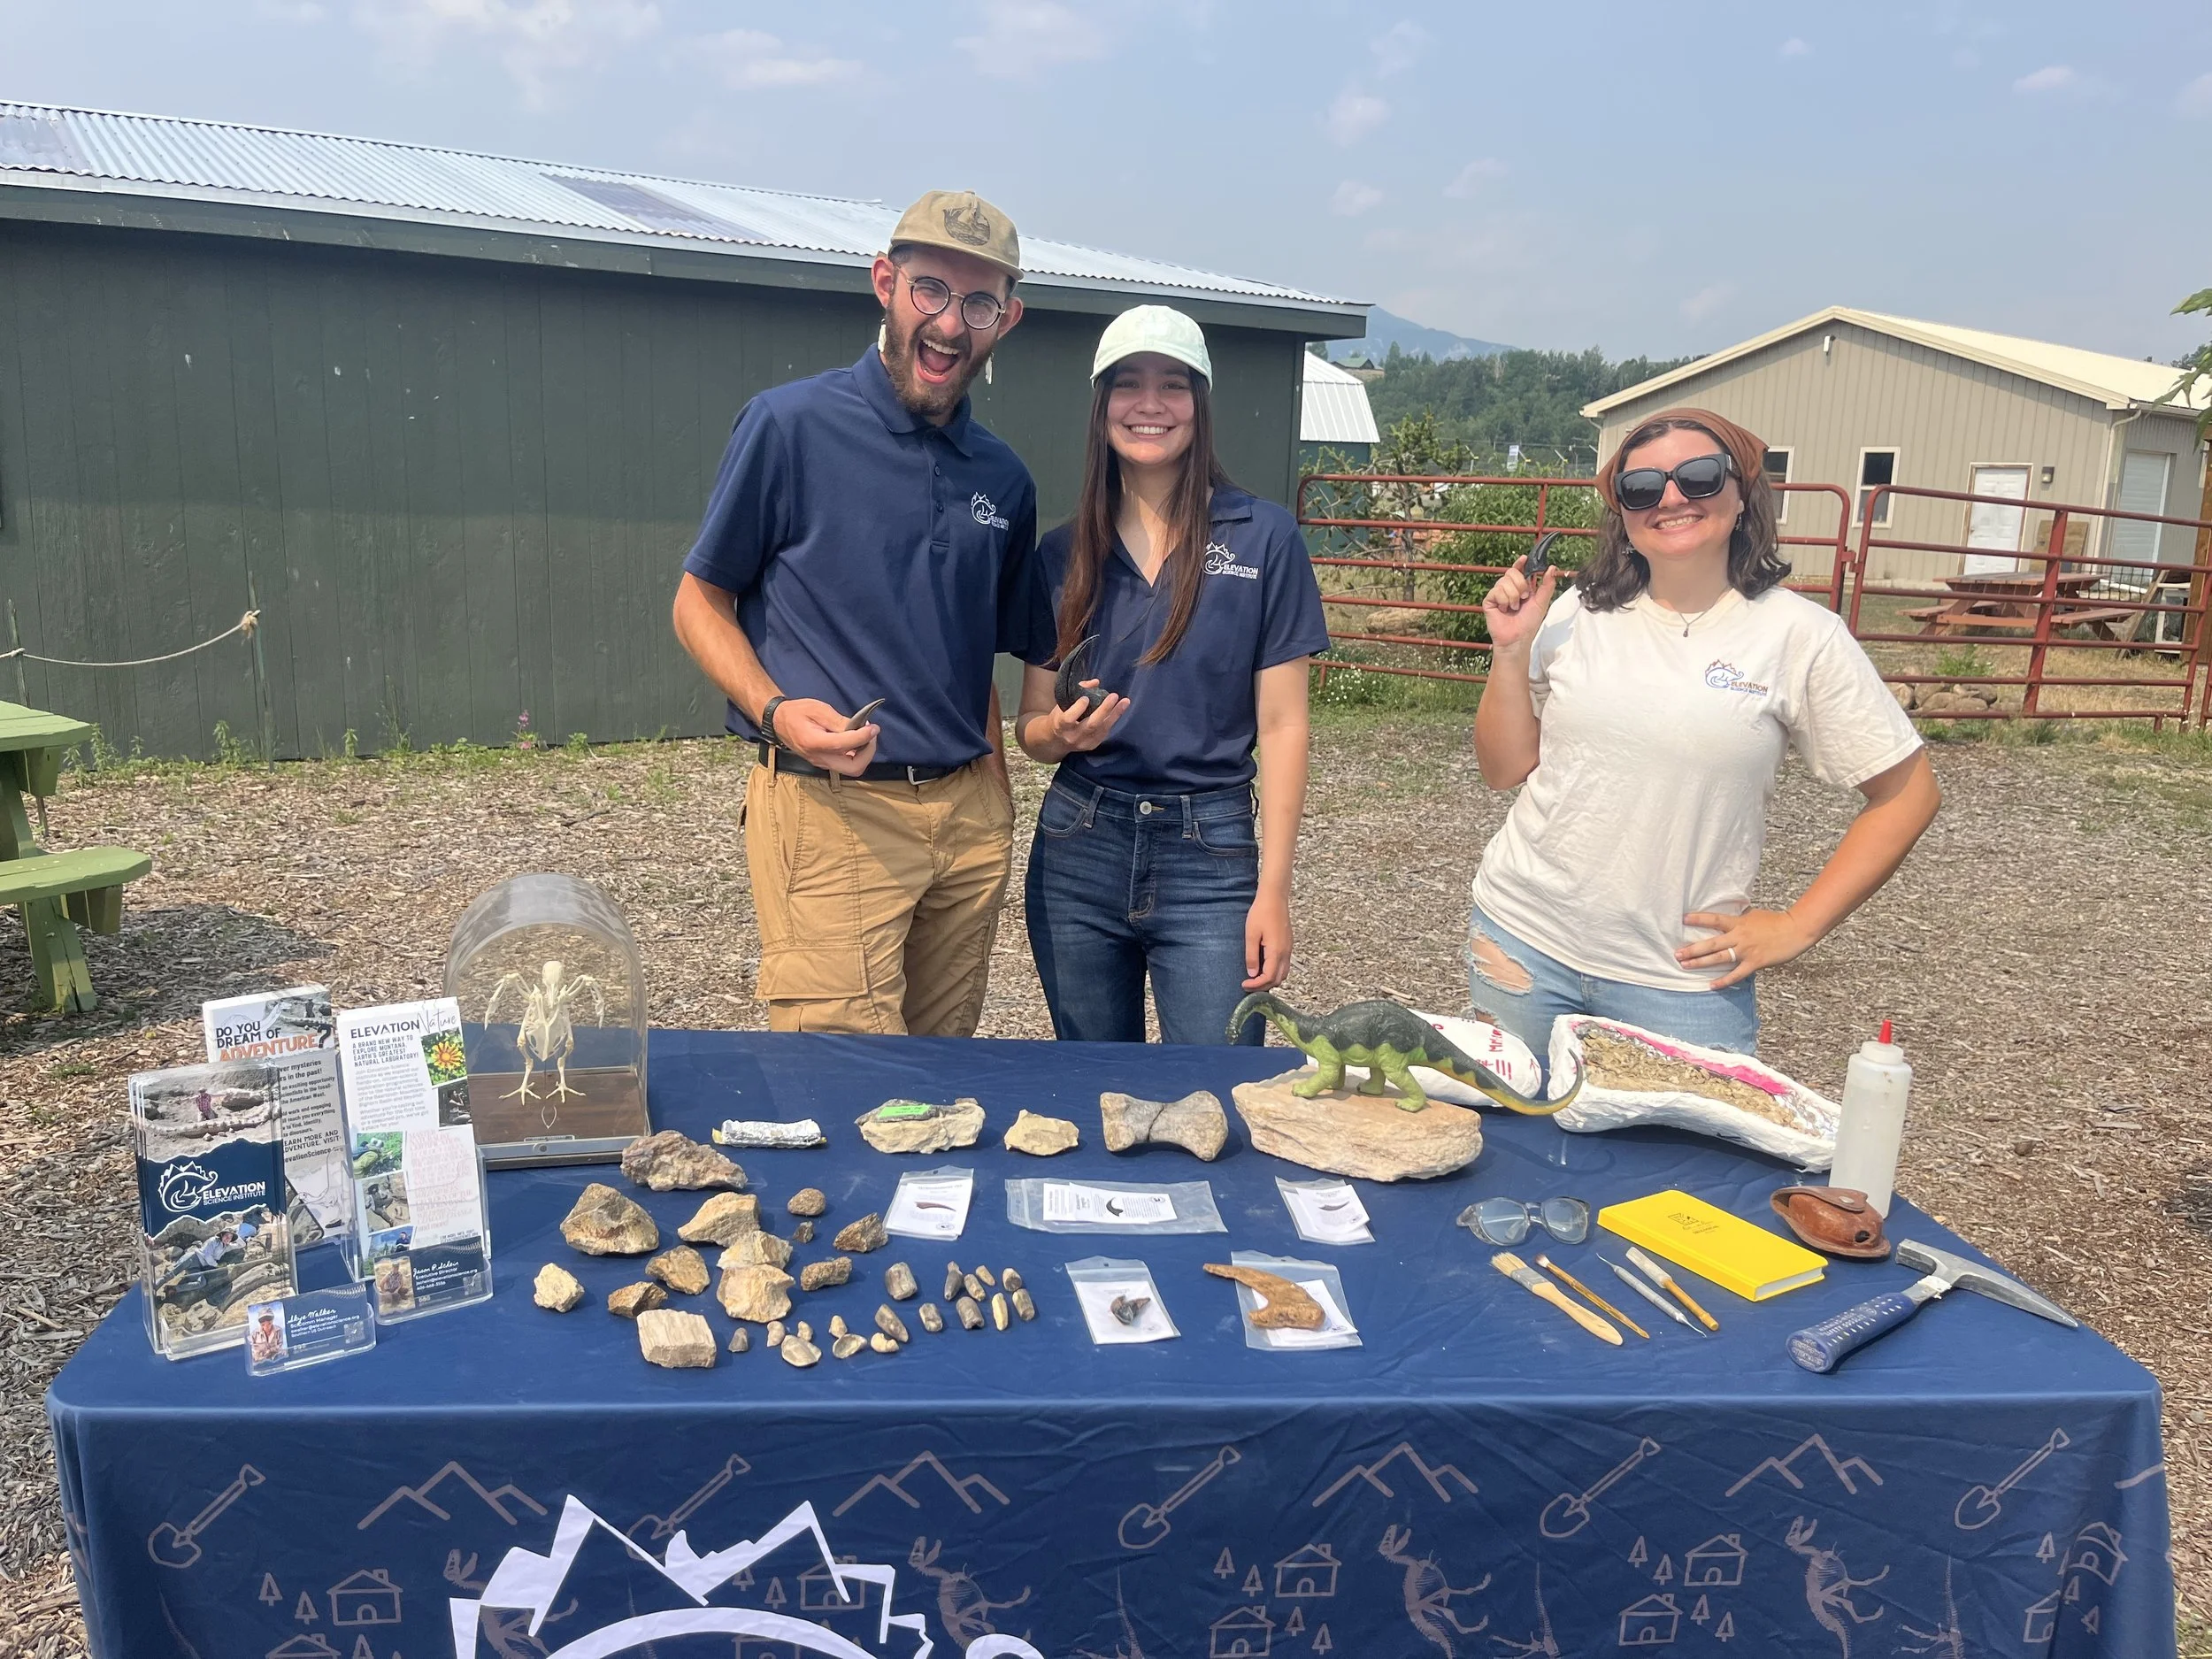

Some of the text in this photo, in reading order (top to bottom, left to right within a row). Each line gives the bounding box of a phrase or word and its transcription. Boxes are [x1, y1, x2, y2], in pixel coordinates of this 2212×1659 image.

[1224, 564, 1259, 575] ELEVATION
[1731, 681, 1769, 692] ELEVATION
[216, 1021, 260, 1038] DO YOU
[350, 1008, 457, 1039] ELEVATION Nature
[217, 1027, 281, 1048] DREAM OF
[357, 1040, 377, 1048] BRAND
[353, 1048, 406, 1061] EARTH'S GREATEST
[354, 1052, 419, 1067] NATURAL LABORATORY!
[291, 1060, 321, 1071] mysteries
[307, 1068, 322, 1078] past!
[284, 1137, 302, 1147] EARN
[304, 1133, 322, 1142] MORE
[203, 1181, 265, 1200] ELEVATION
[203, 1190, 265, 1205] SCIENCE INSTITUTE
[415, 1271, 439, 1280] Executive
[286, 1308, 337, 1326] Skye Walker
[316, 1314, 339, 1323] Manager
